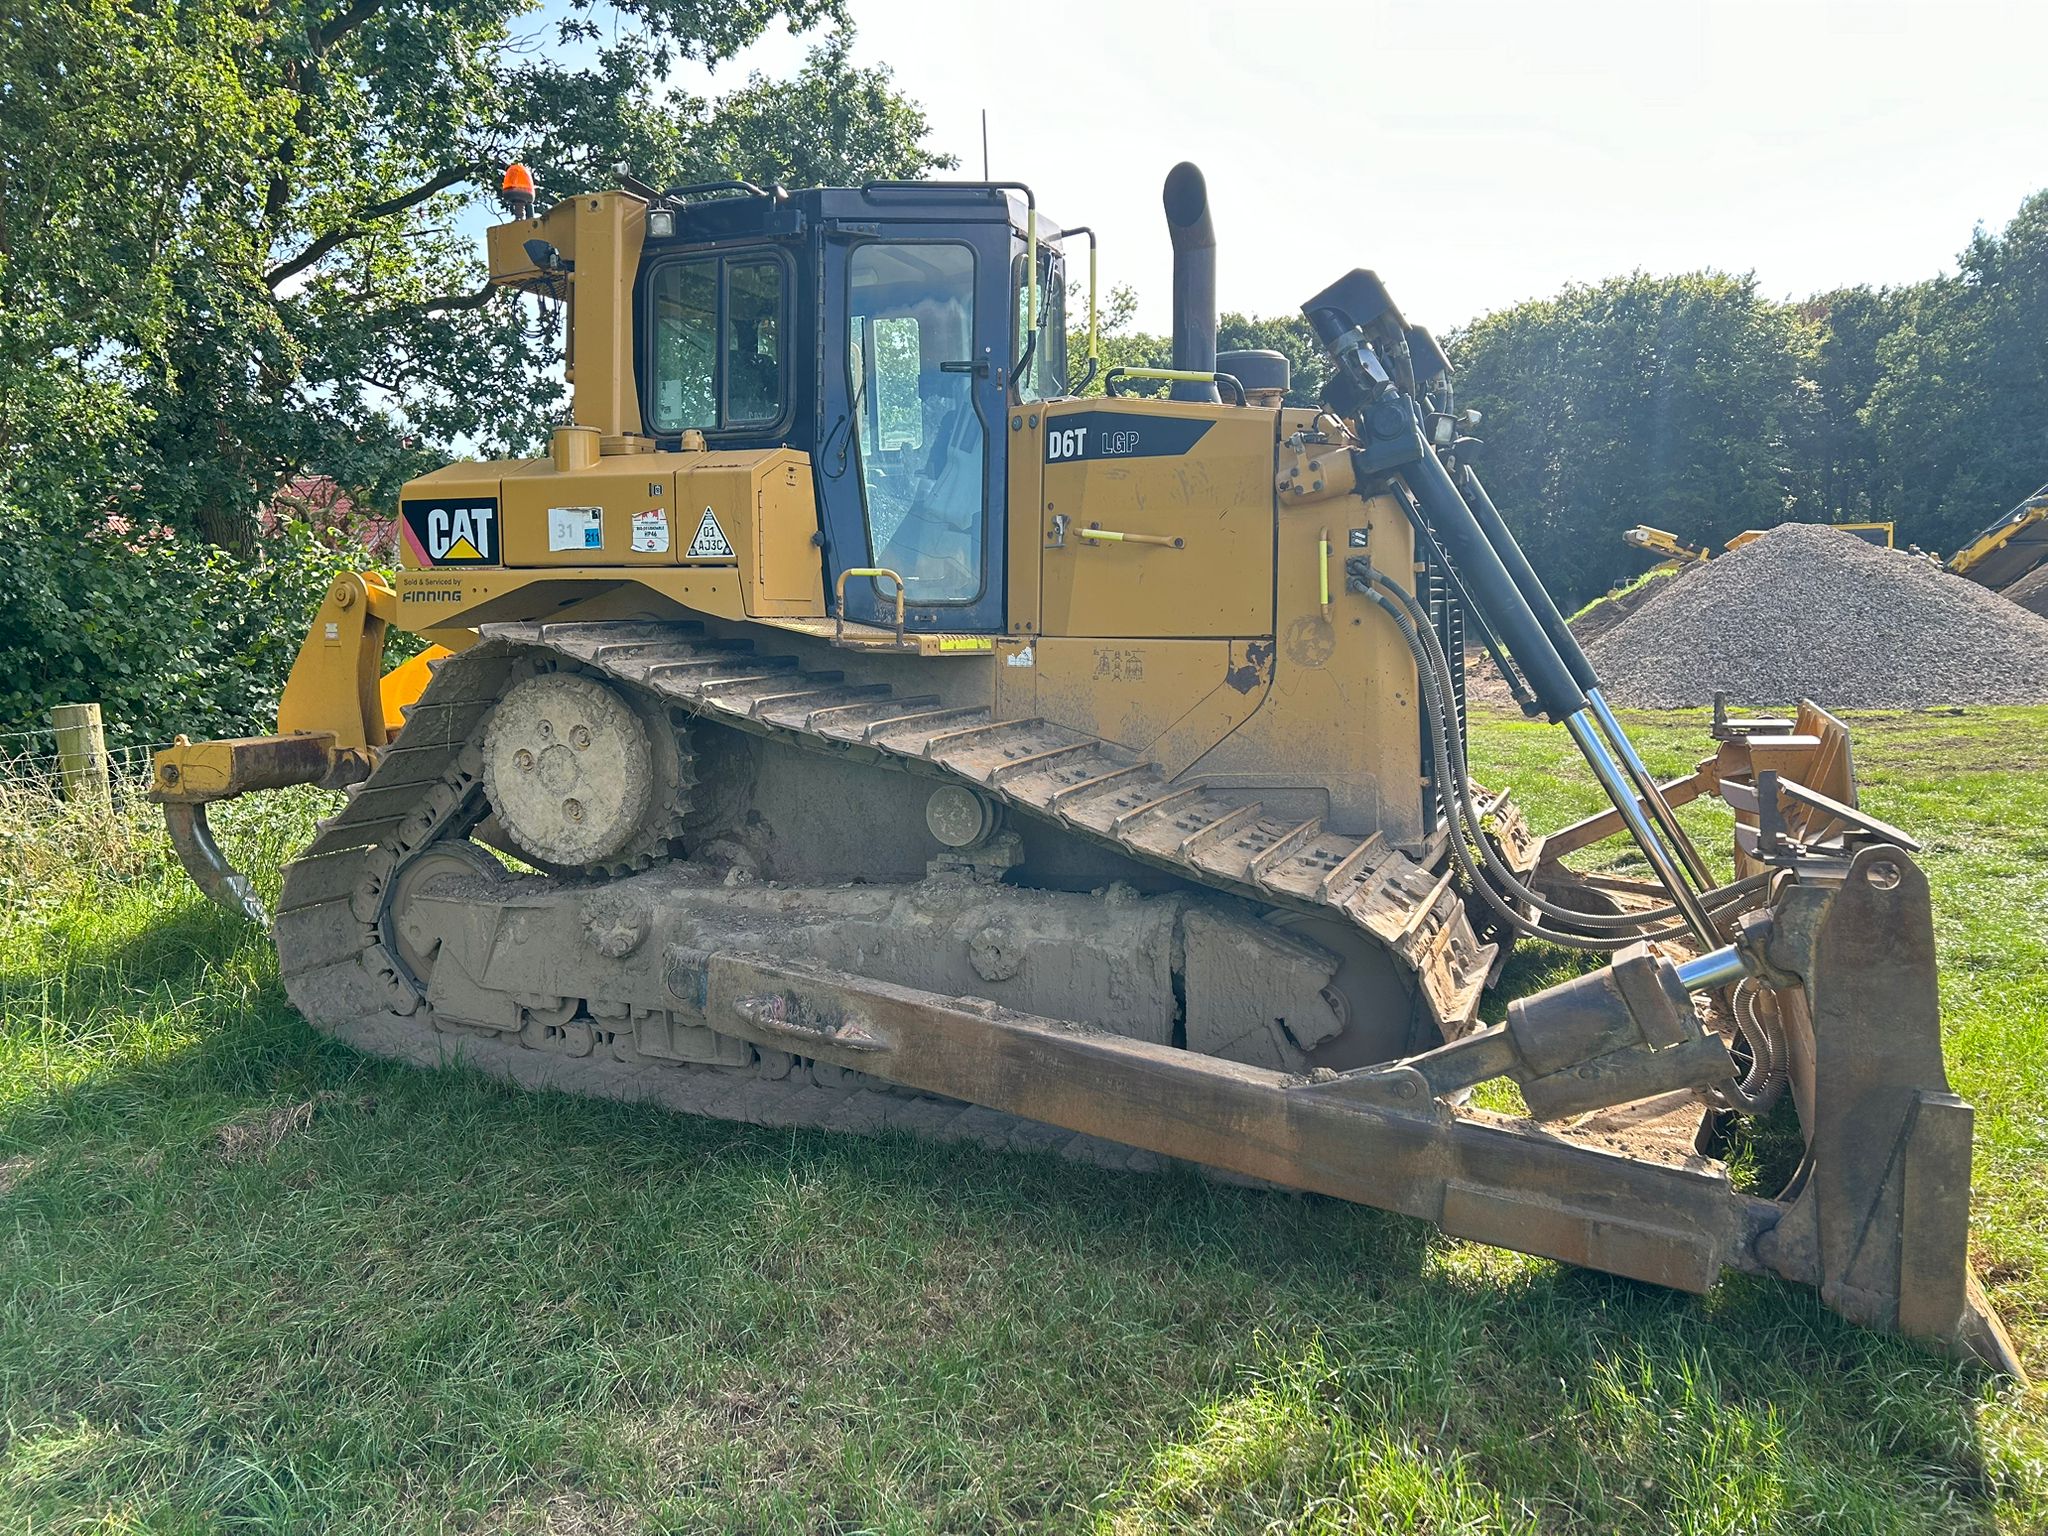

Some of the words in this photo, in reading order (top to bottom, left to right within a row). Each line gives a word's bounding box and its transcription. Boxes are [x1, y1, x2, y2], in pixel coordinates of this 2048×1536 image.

[1049, 427, 1087, 459] D6T
[1101, 431, 1140, 454] LGP
[427, 508, 492, 559] CAT
[557, 523, 573, 538] 31
[703, 526, 715, 538] 01
[453, 579, 462, 587] by
[402, 590, 462, 602] FINNING
